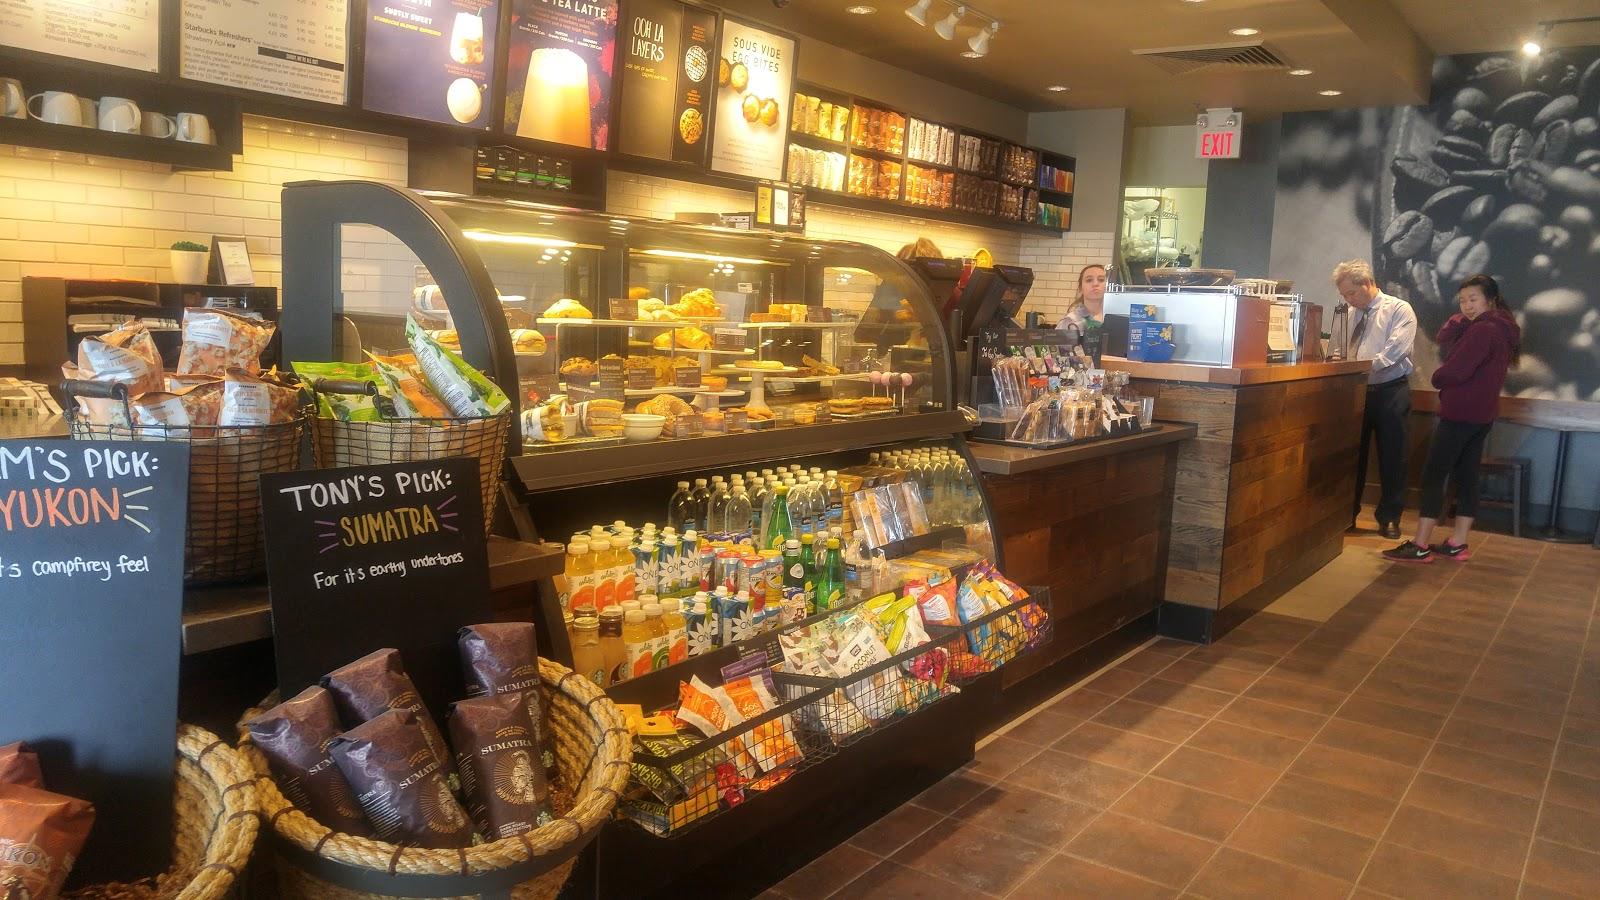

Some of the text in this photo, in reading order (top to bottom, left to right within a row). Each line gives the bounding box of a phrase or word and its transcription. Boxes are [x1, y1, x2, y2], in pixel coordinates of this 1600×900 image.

[552, 0, 607, 20] TEA LATTE
[184, 22, 217, 36] Starbucks
[633, 16, 664, 44] OOH LA
[631, 36, 665, 62] LAYERS
[732, 51, 780, 73] EGG BITES
[733, 37, 781, 60] SOUS VIDE
[1201, 131, 1234, 157] EXIT
[0, 446, 160, 483] M'S PICK:
[279, 469, 453, 512] TONY'S PICK:
[0, 487, 120, 531] YUKON
[339, 504, 440, 547] SUMATRA
[32, 556, 112, 581] campfirey
[116, 554, 150, 574] feel
[313, 571, 340, 589] For
[369, 560, 407, 578] earthy
[411, 552, 464, 569] undertones
[850, 644, 877, 674] COCONUT
[481, 739, 533, 756] SUMATRA
